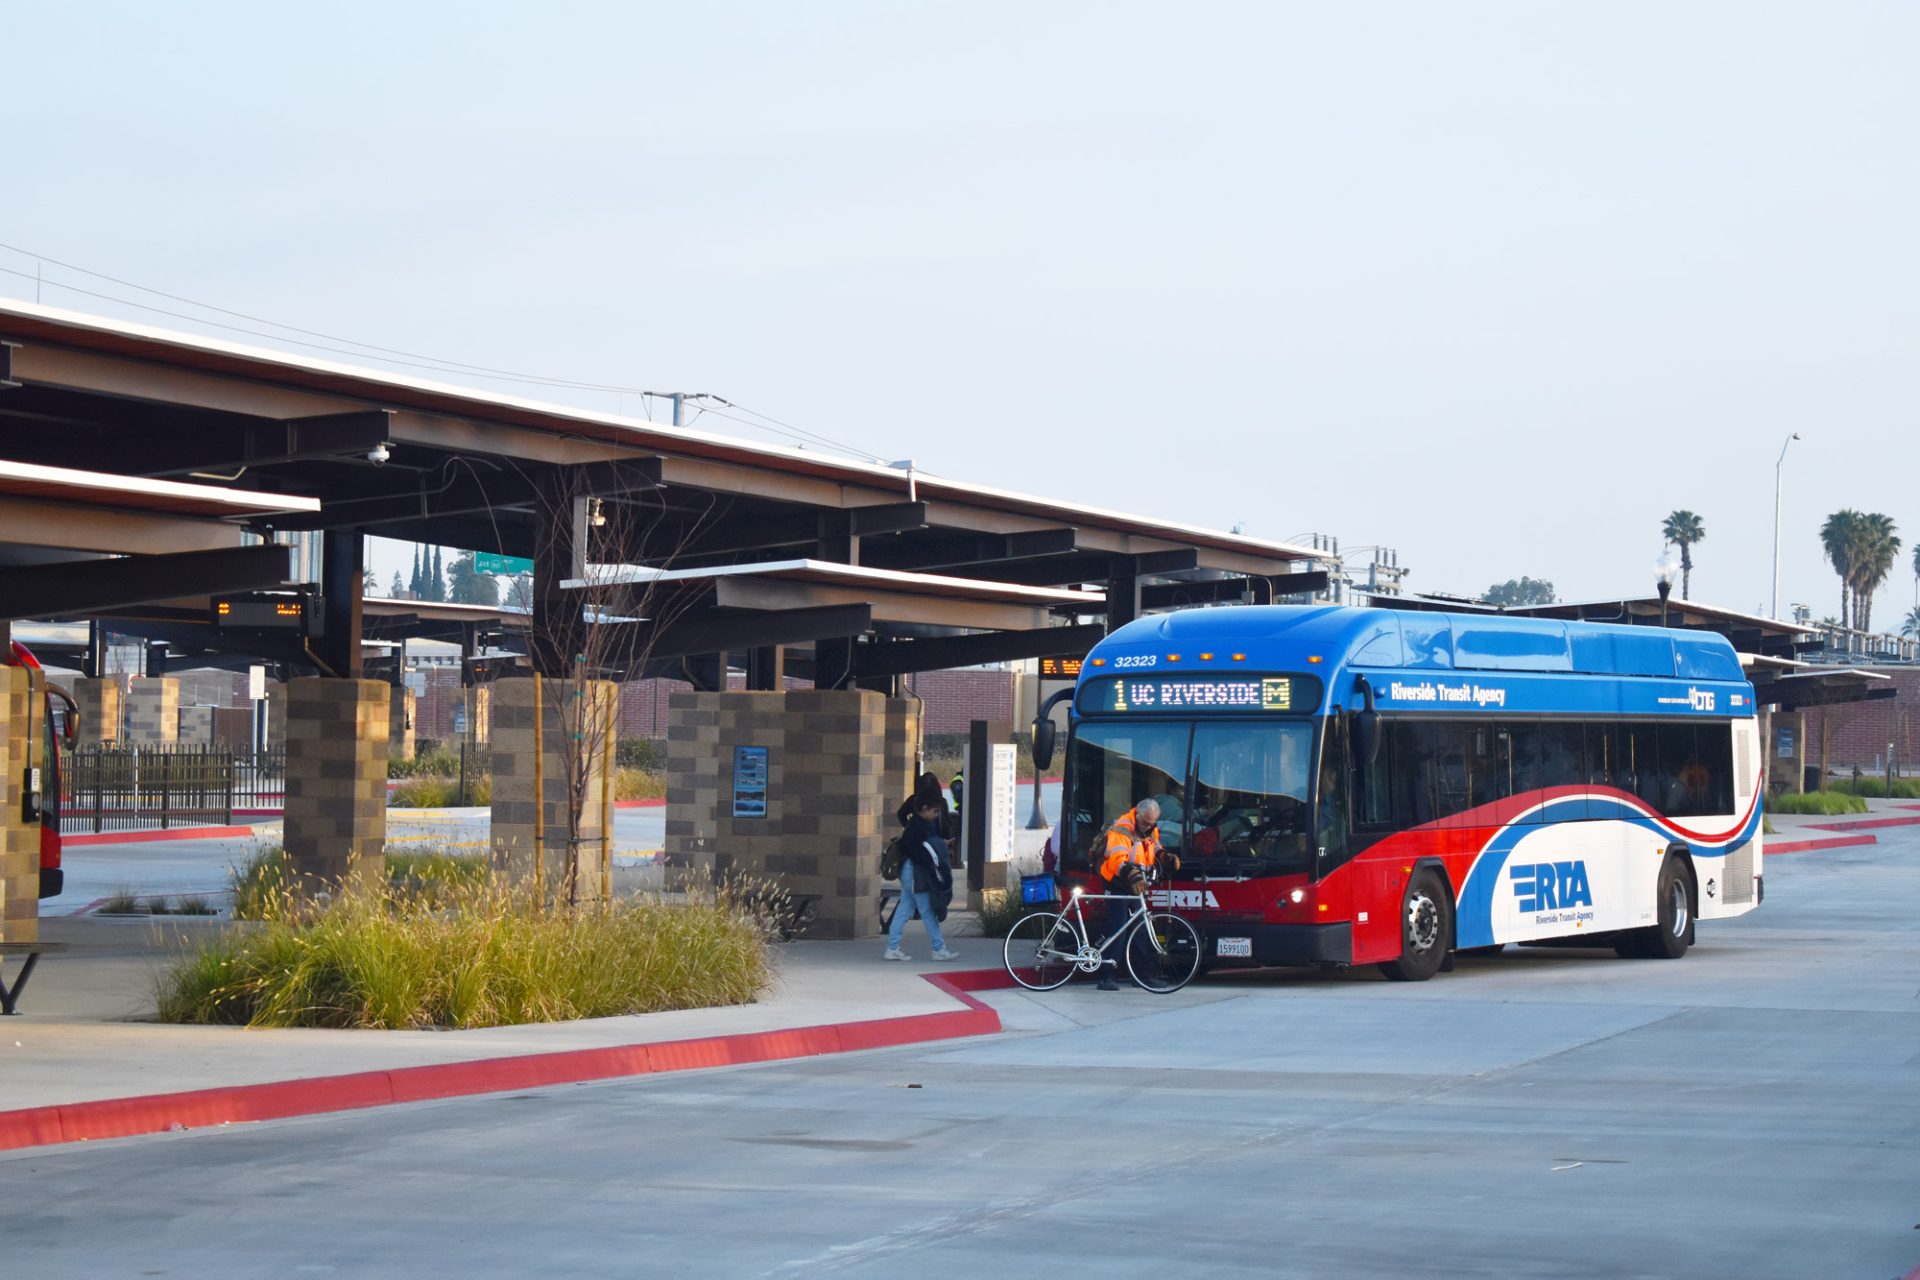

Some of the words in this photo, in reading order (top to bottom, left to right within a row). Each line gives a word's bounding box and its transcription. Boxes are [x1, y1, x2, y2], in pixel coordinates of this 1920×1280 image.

[1114, 655, 1157, 668] 32323
[1114, 680, 1127, 710] 1
[1131, 684, 1155, 705] UC
[1161, 683, 1260, 705] RIVERSIDE
[1391, 681, 1436, 700] Riverside
[1437, 683, 1471, 702] Transit
[1473, 685, 1505, 707] Agency
[1535, 912, 1558, 925] Riverside
[1559, 911, 1576, 922] Transit
[1577, 911, 1594, 923] Agency
[1219, 944, 1249, 954] 1599100
